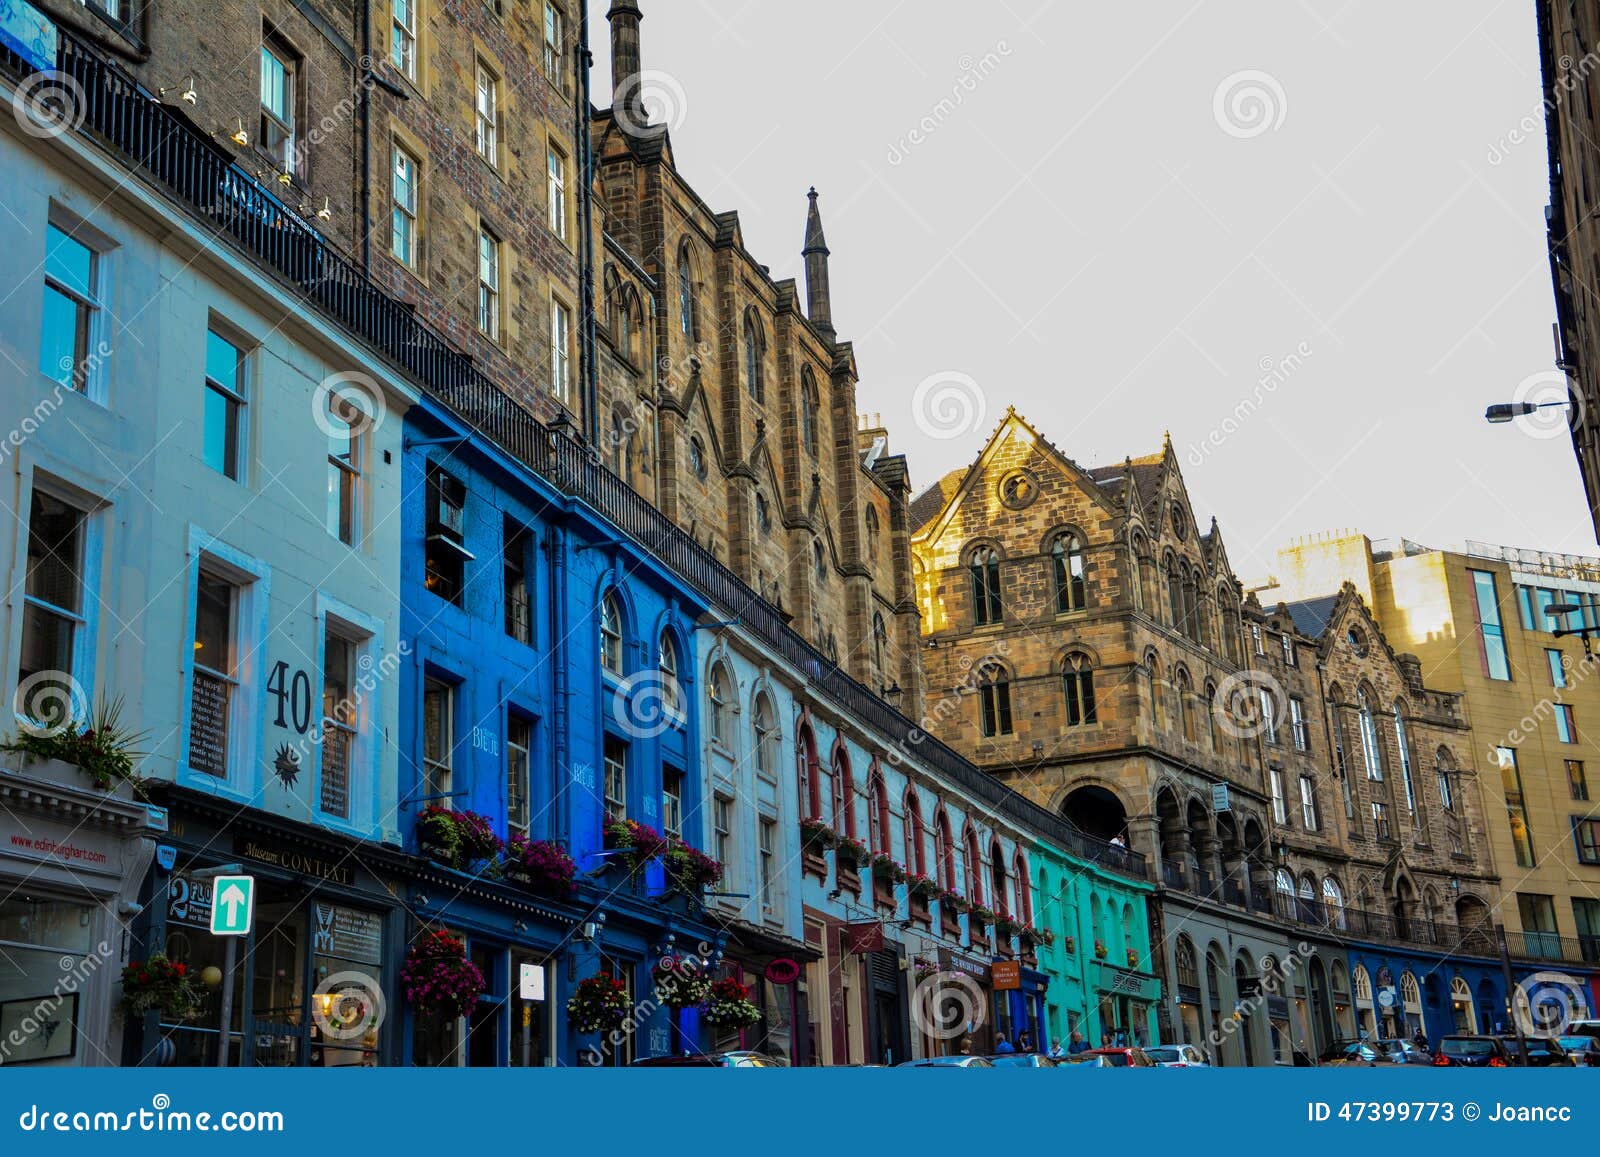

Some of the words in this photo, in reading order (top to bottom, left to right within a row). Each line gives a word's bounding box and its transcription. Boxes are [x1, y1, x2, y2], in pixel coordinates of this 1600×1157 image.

[267, 661, 310, 734] 40
[10, 834, 107, 864] www.edinburghart.com
[245, 842, 279, 864] Museum
[280, 851, 350, 885] CONTEXT
